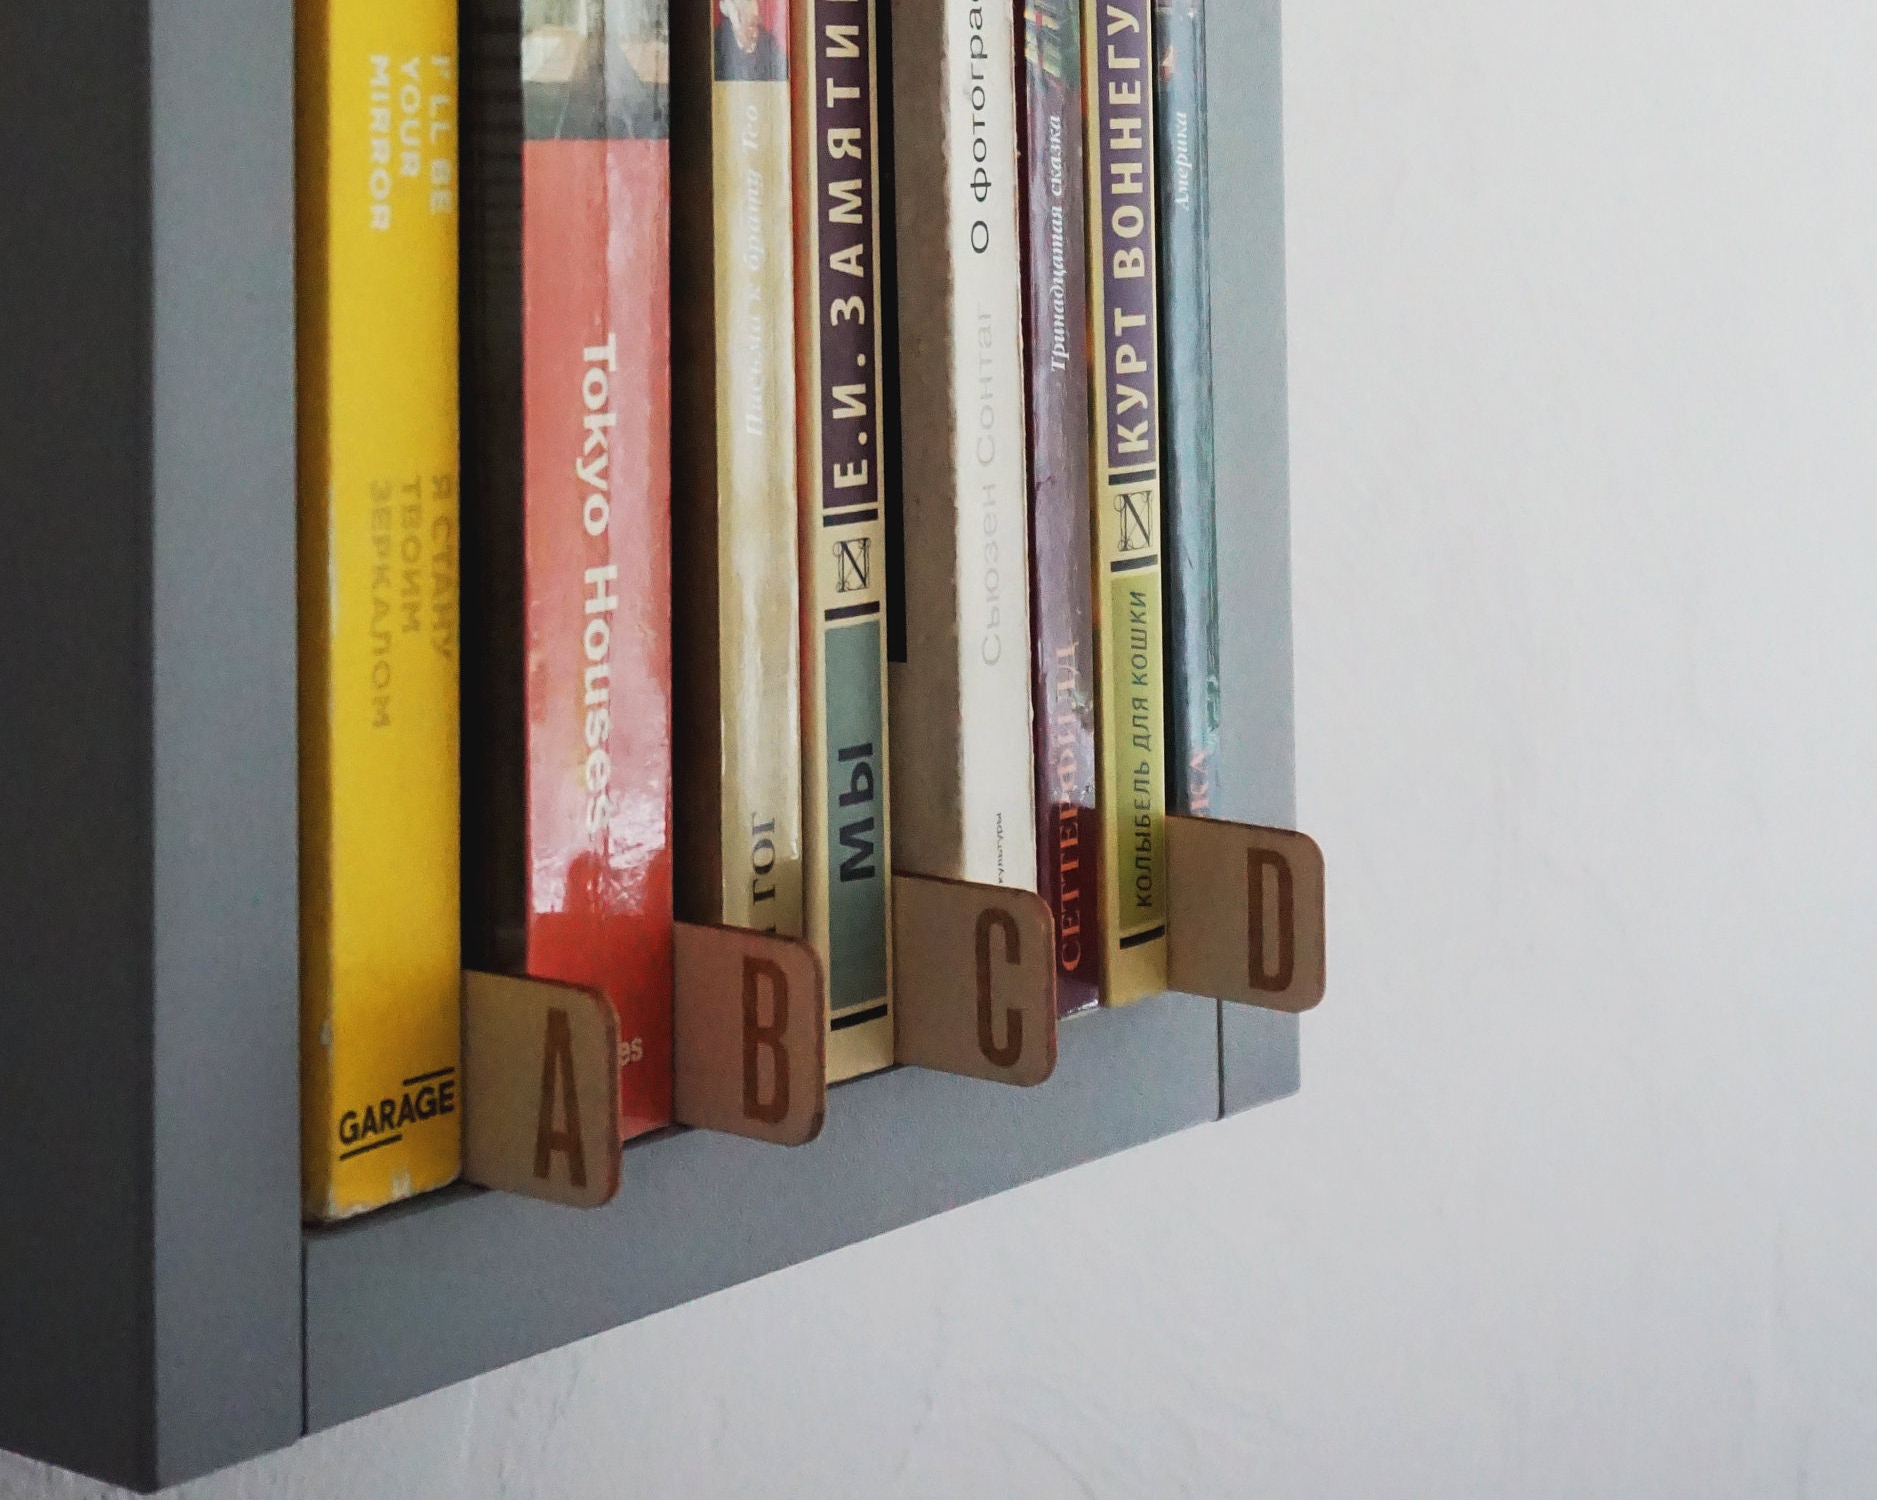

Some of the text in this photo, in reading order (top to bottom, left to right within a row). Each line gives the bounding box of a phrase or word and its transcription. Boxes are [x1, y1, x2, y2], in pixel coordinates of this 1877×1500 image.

[369, 54, 391, 231] MIRROR
[400, 56, 421, 177] YOUR
[430, 158, 452, 213] BE
[1175, 112, 1191, 211] Америка
[971, 220, 989, 255] О
[1049, 115, 1070, 373] Тринадцатая сказка
[1114, 307, 1149, 454] КУРТ
[400, 474, 421, 633] ТВОИМ
[976, 312, 1000, 668] Сьюзен Сонтаг
[368, 478, 392, 728] ЗЕРКАЛОМ
[577, 333, 619, 835] Tokyo Houses
[838, 742, 877, 883] МЫ
[1130, 590, 1153, 908] КОЛЫБЕЛЬ ДЛЯ КОШКИ
[975, 908, 1023, 1067] C
[1246, 846, 1294, 991] D
[339, 1079, 455, 1145] GARAGE
[533, 1007, 587, 1188] A
[742, 954, 790, 1124] B
